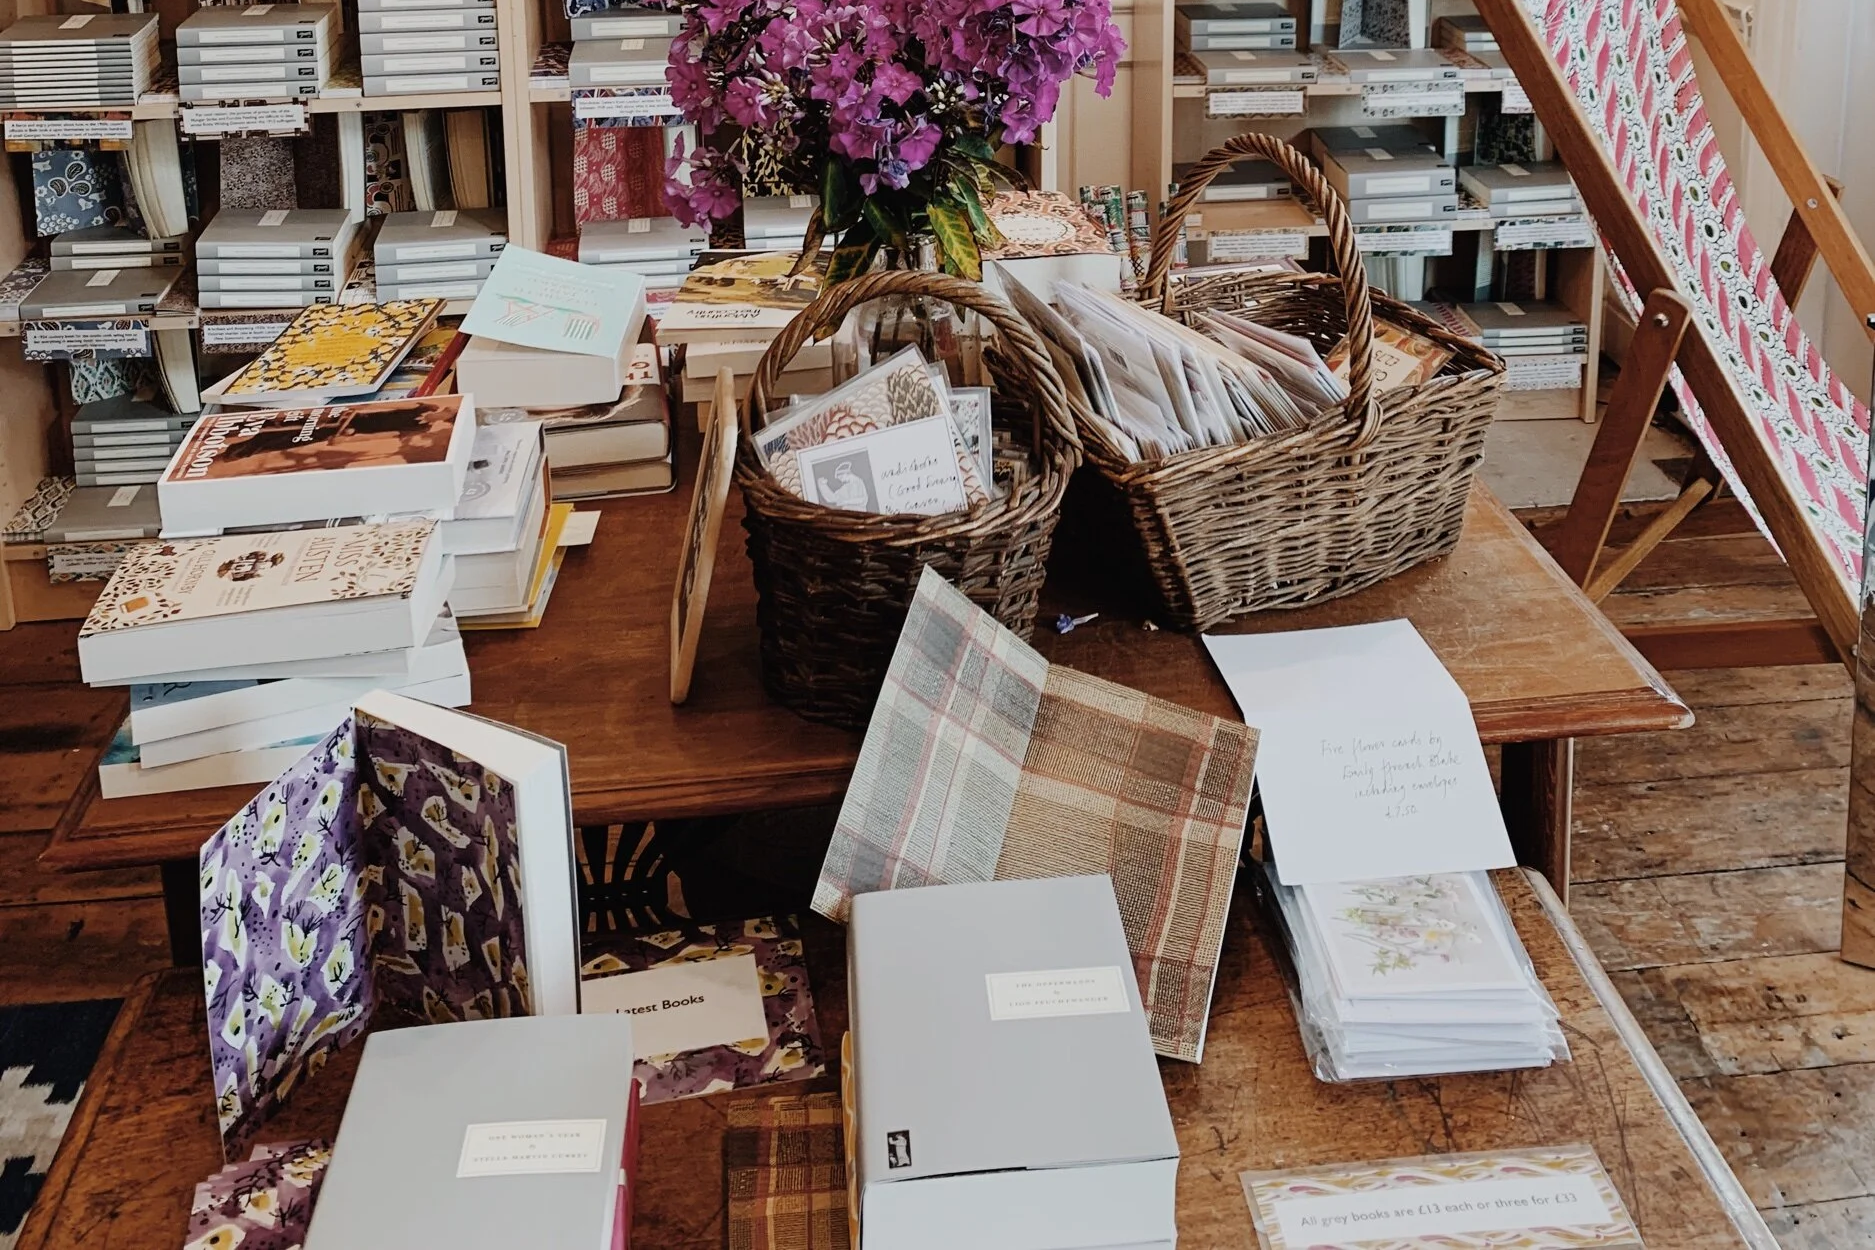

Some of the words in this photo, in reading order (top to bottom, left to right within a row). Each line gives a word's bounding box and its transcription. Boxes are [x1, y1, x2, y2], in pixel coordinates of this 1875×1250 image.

[237, 411, 276, 439] Eva
[292, 407, 324, 444] morning
[184, 412, 240, 478] Ibbotson
[197, 549, 216, 568] GILL
[294, 536, 338, 583] AUSTEN
[334, 538, 369, 567] MISS
[178, 565, 206, 596] HORNBY
[1320, 739, 1344, 757] Five
[1352, 737, 1385, 763] flower
[1392, 731, 1421, 748] cards
[1429, 730, 1442, 754] by
[1342, 764, 1374, 787] Emily
[1354, 783, 1406, 804] including
[662, 993, 705, 1010] Books
[1301, 1216, 1318, 1227] All
[1321, 1212, 1348, 1229] grey
[1352, 1209, 1391, 1223] books
[1394, 1207, 1414, 1218] are
[1418, 1203, 1441, 1216] £13
[1444, 1200, 1473, 1214] each
[1476, 1200, 1491, 1211] or
[1494, 1196, 1529, 1209] three
[1531, 1193, 1550, 1206] for
[1554, 1192, 1578, 1205] £33
